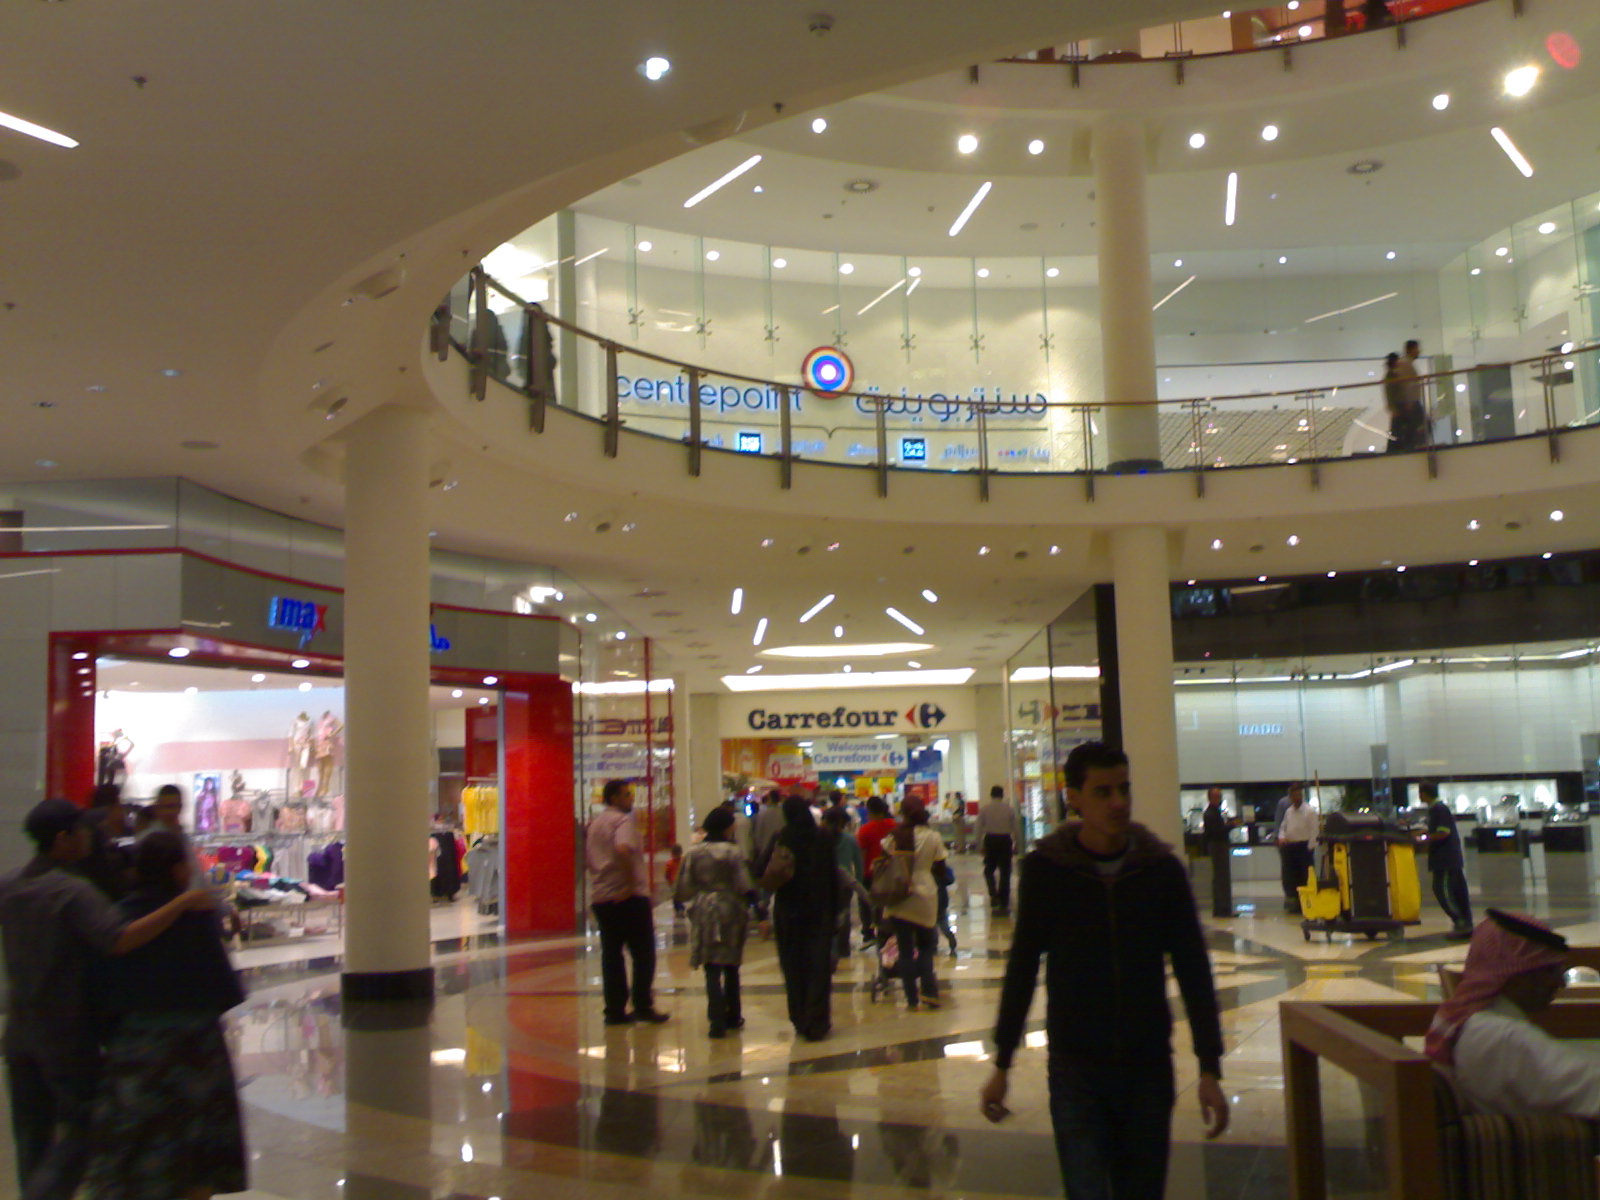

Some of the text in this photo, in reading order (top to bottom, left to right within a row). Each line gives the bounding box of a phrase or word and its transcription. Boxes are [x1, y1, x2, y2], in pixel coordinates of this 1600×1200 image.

[617, 375, 802, 412] centepoint
[272, 596, 329, 640] max
[748, 706, 898, 730] Carrefour
[813, 751, 879, 764] Carrefour
[826, 741, 893, 752] Welcome to
